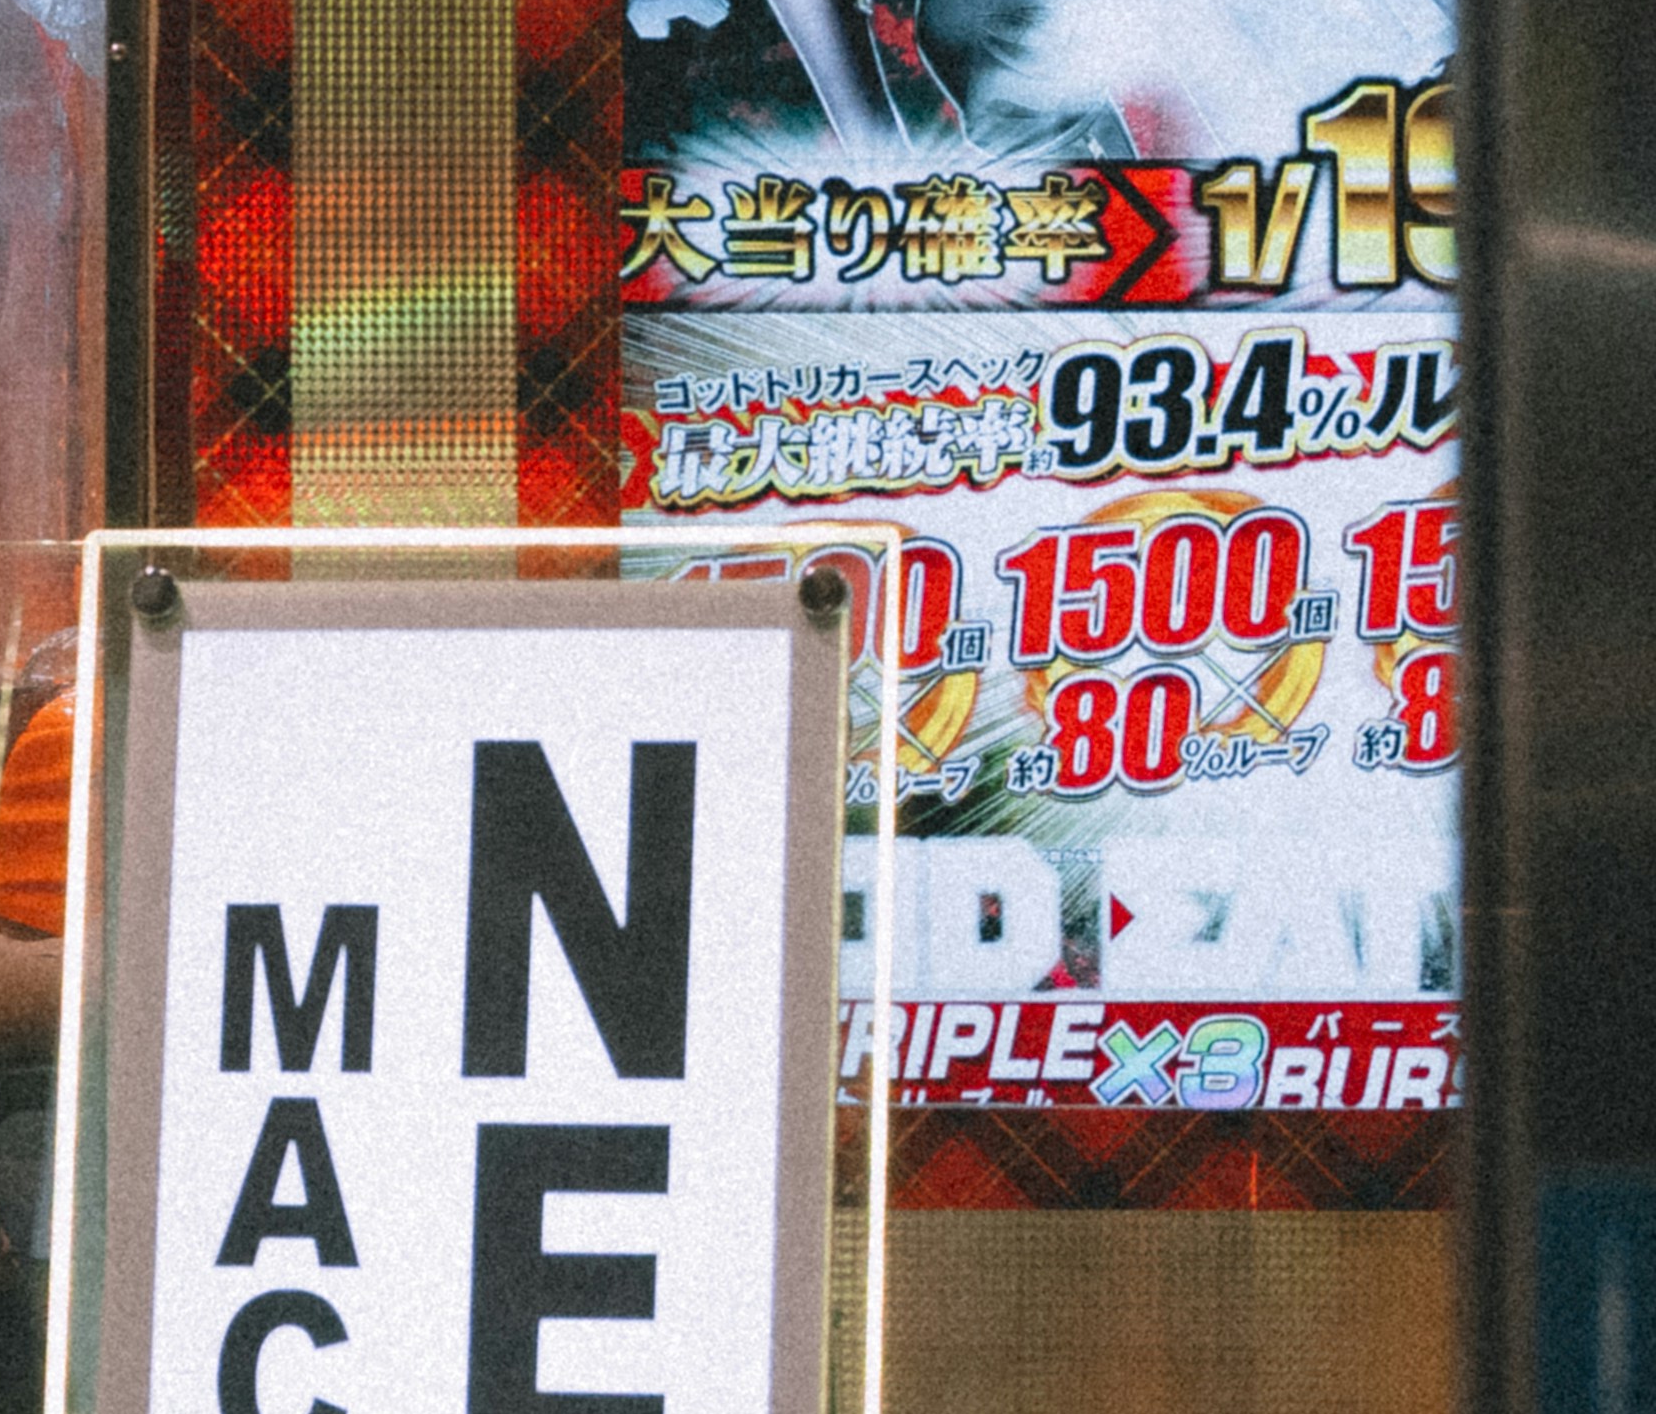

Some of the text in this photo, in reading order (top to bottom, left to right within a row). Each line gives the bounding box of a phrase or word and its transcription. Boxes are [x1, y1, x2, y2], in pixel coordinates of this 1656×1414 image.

[618, 174, 1111, 284] 大当り確率
[838, 1003, 1107, 1081] RIPLE
[1265, 1046, 1463, 1109] BUR
